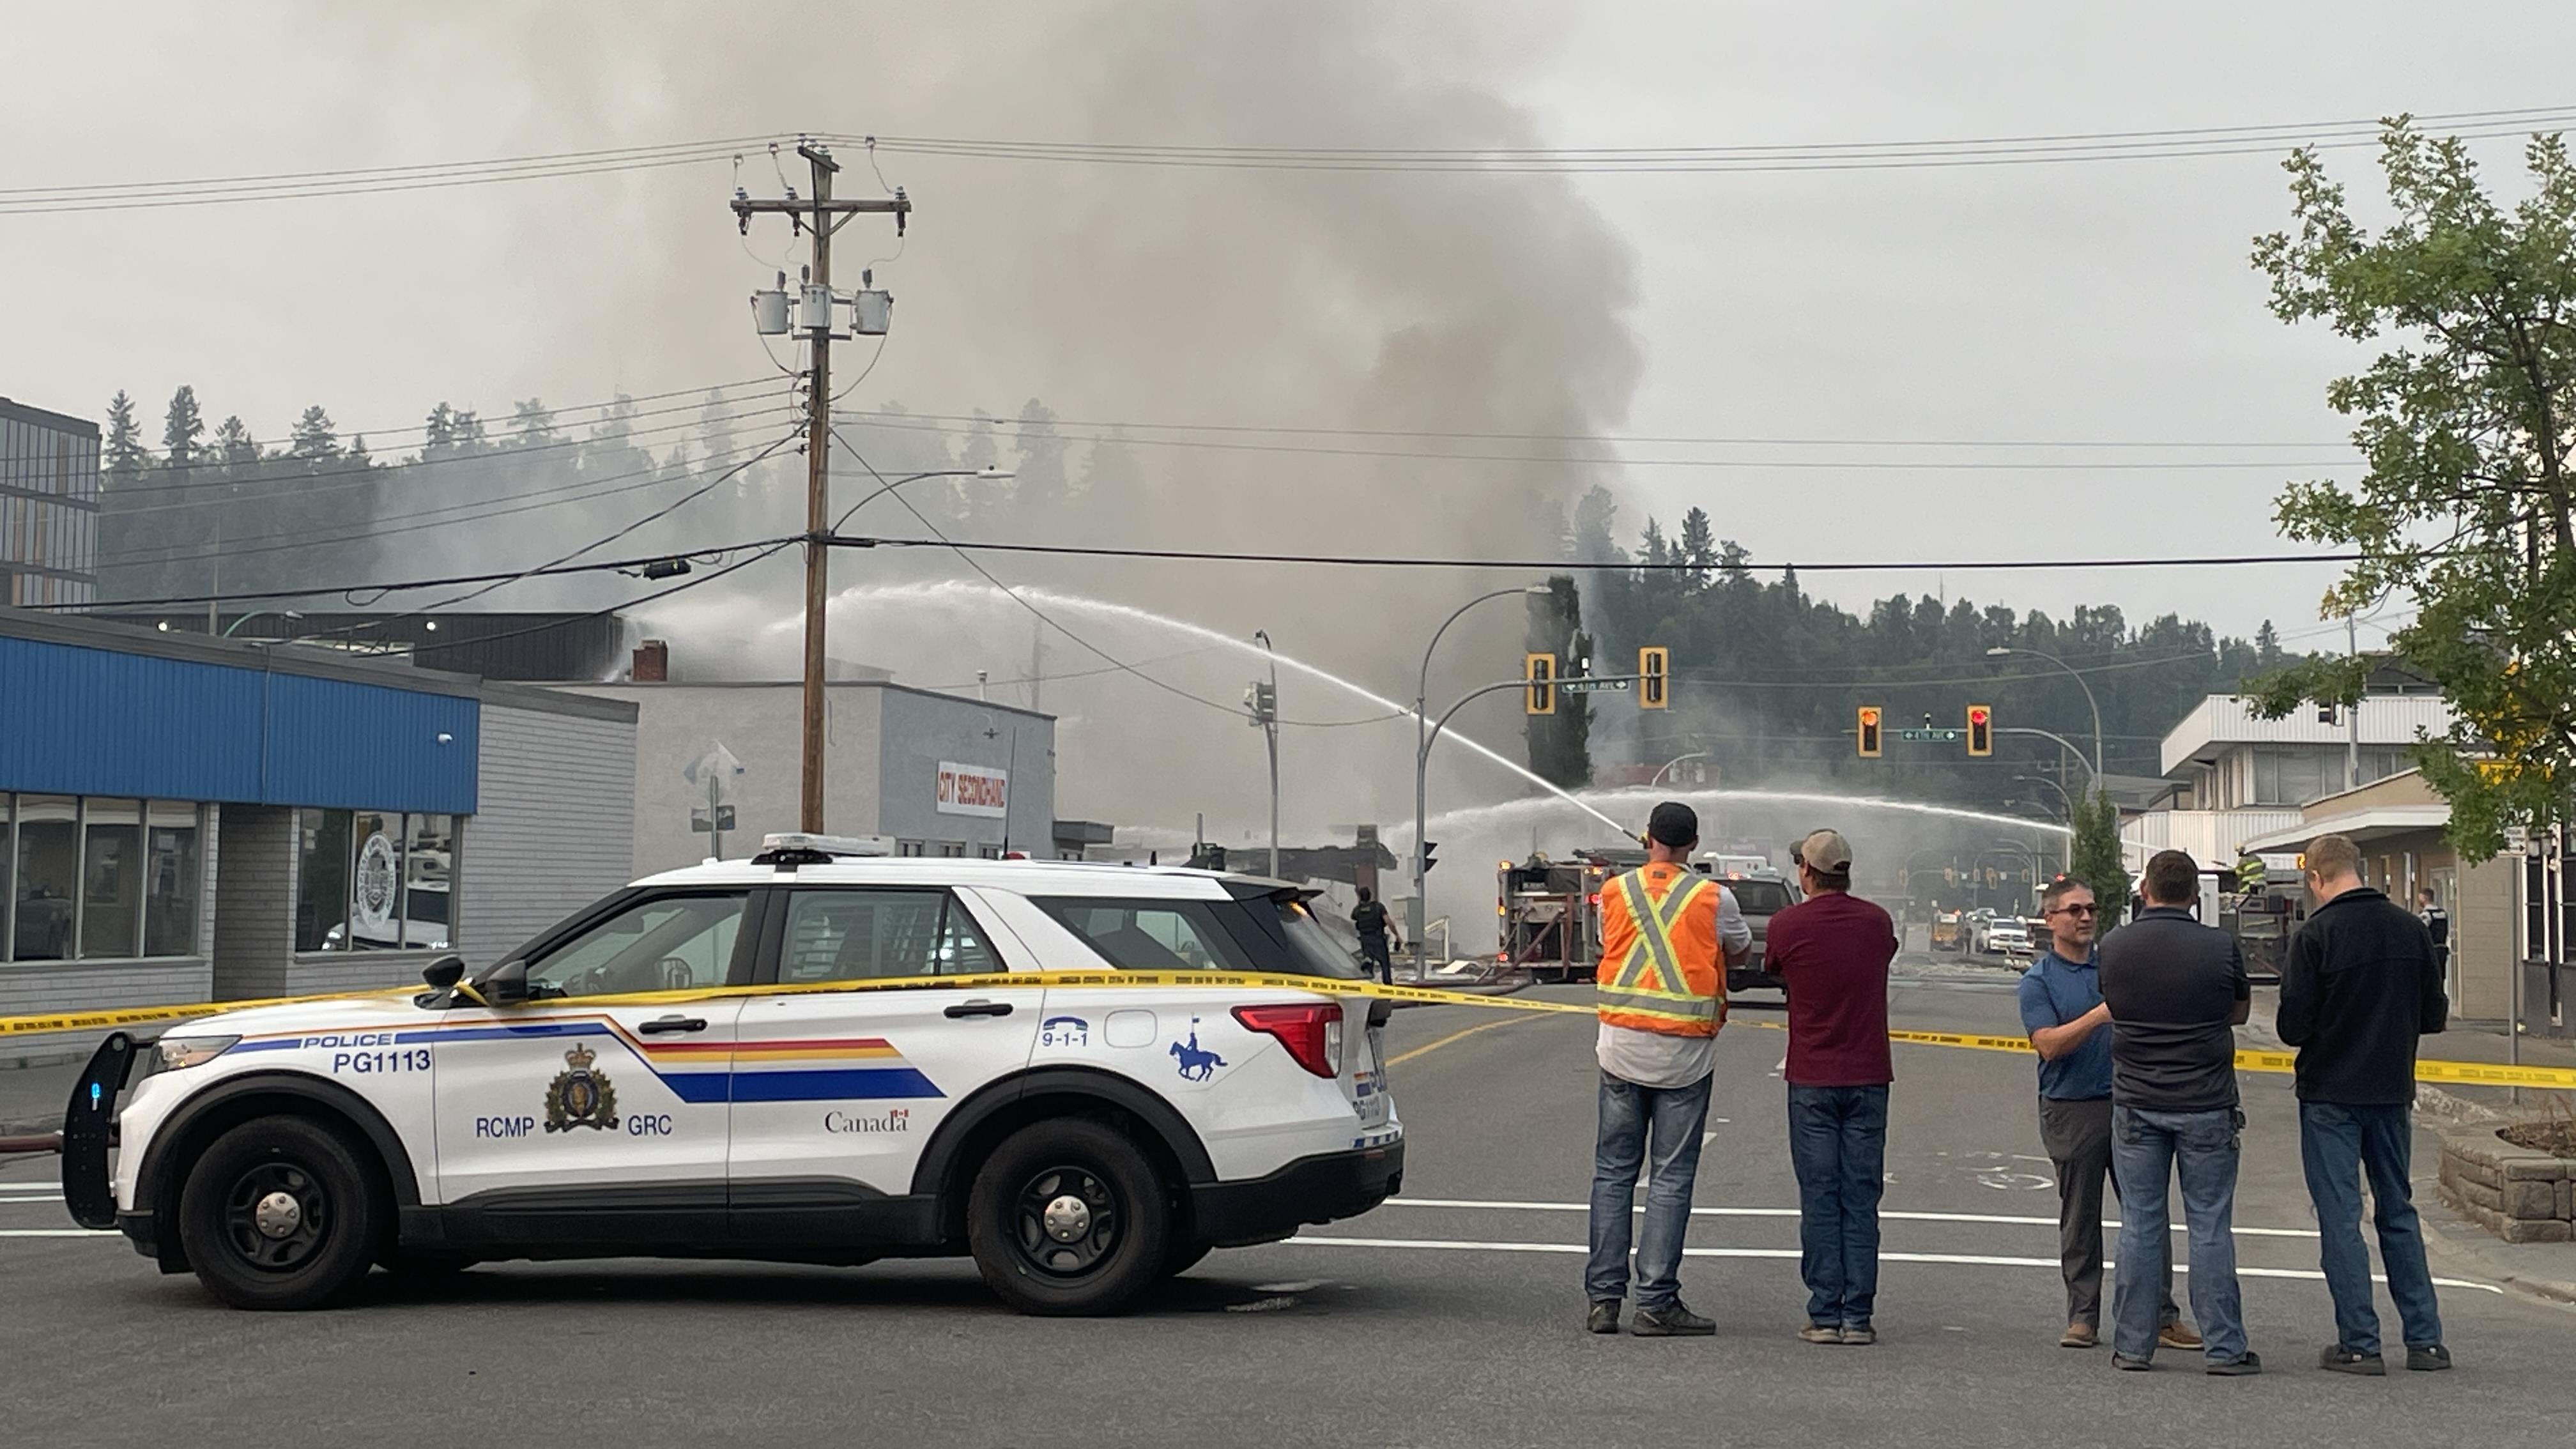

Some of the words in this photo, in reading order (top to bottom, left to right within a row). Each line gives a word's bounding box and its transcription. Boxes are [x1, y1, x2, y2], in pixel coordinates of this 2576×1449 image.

[939, 771, 956, 804] CITY
[303, 1033, 393, 1049] POLICE
[1042, 1032, 1087, 1046] 9-1-1
[333, 1050, 431, 1074] PG1113
[476, 1117, 535, 1137] RCMP
[627, 1115, 672, 1135] GRC
[824, 1110, 909, 1133] Canada
